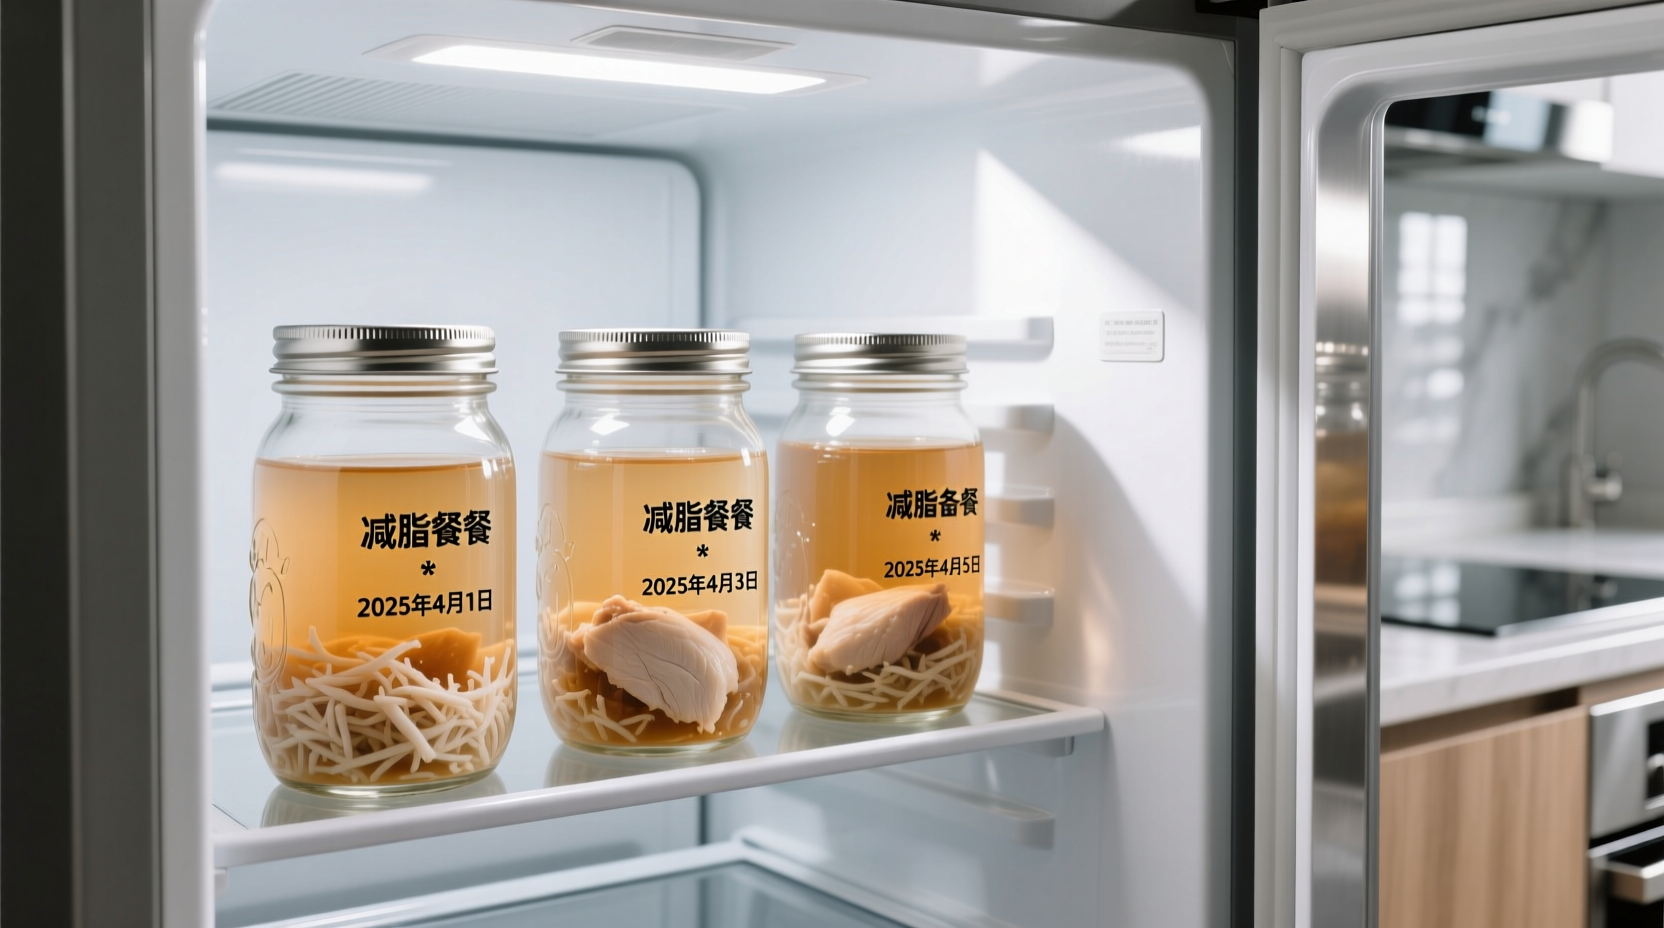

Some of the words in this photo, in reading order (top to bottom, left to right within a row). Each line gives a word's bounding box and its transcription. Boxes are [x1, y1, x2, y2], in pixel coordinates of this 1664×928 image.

[885, 488, 978, 520] 减脂备餐
[884, 555, 980, 578] 2025年4月5日
[642, 571, 758, 596] 2025年4月3日
[357, 589, 492, 618] 2025年4月1日
